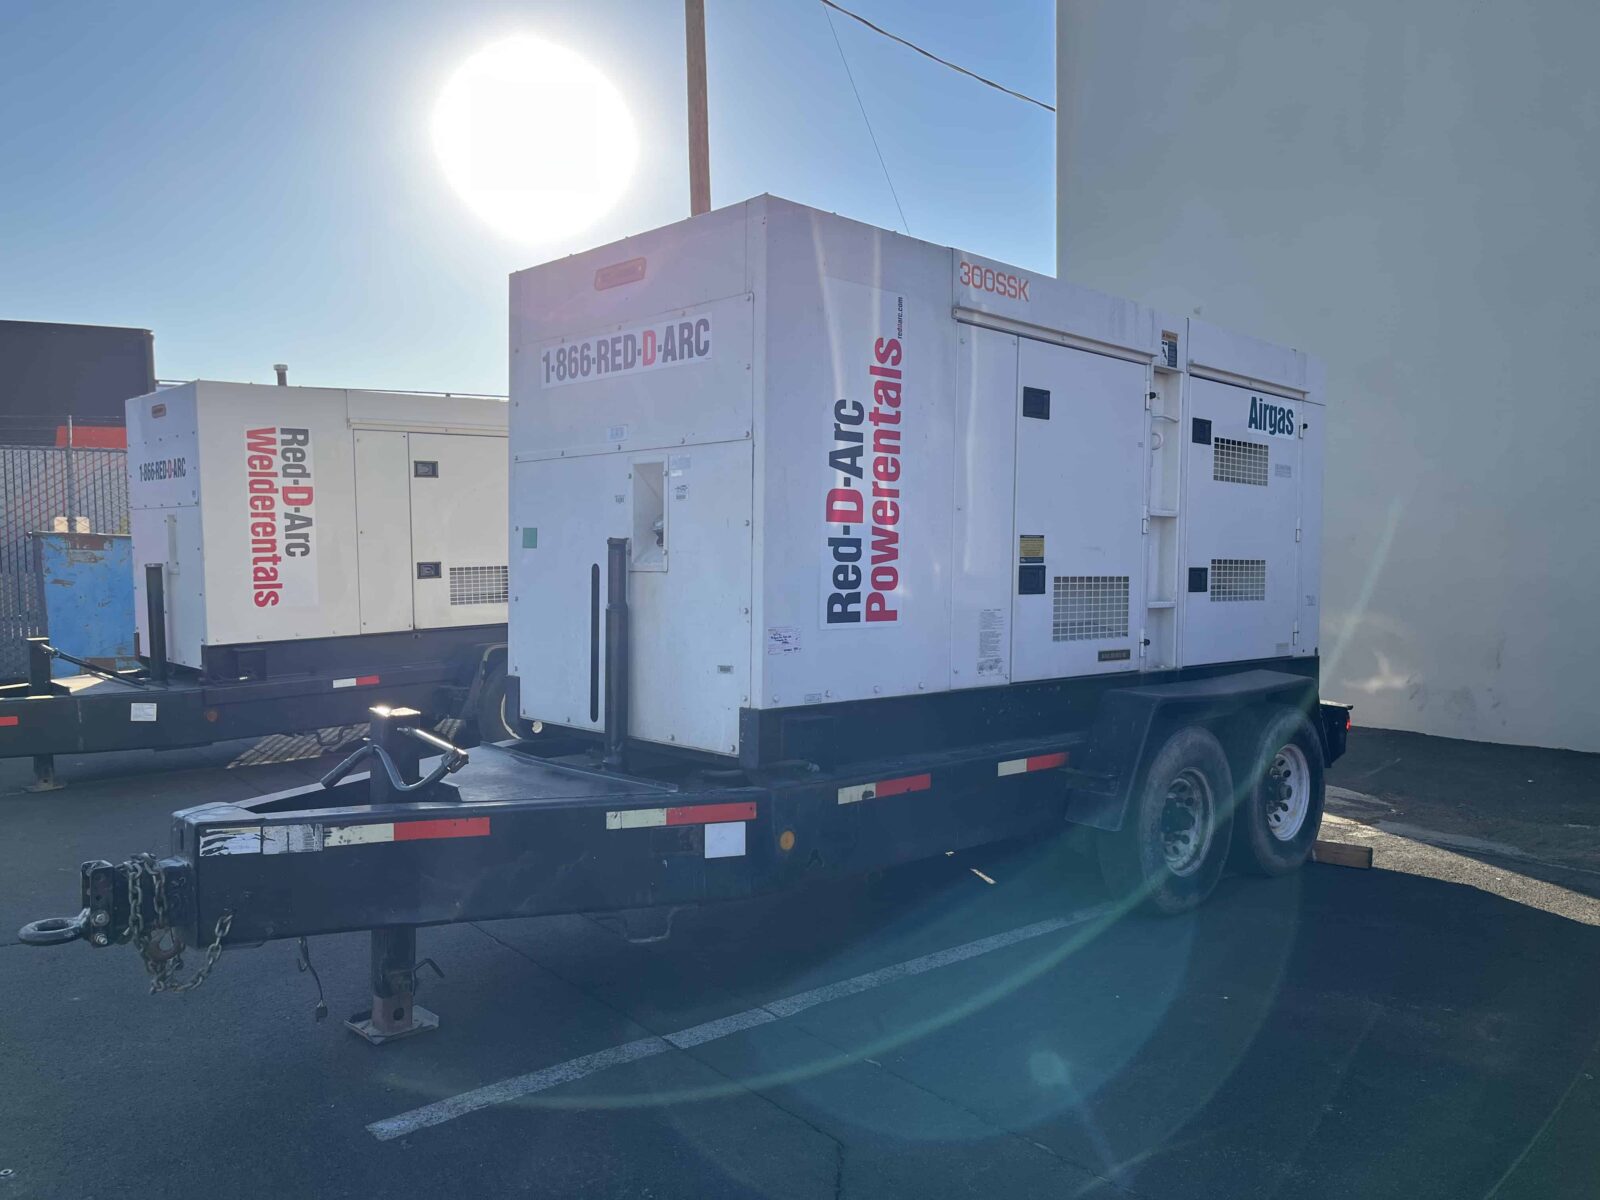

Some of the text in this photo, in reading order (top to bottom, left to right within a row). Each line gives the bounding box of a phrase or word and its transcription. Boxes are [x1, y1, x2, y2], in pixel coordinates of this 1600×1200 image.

[959, 261, 1030, 302] 300SSK
[279, 427, 314, 558] Red-D-Arc
[865, 337, 903, 622] Powerentals
[1248, 396, 1294, 436] Airgas
[246, 427, 283, 608] Welderentals
[826, 399, 865, 624] Red-D-Arc
